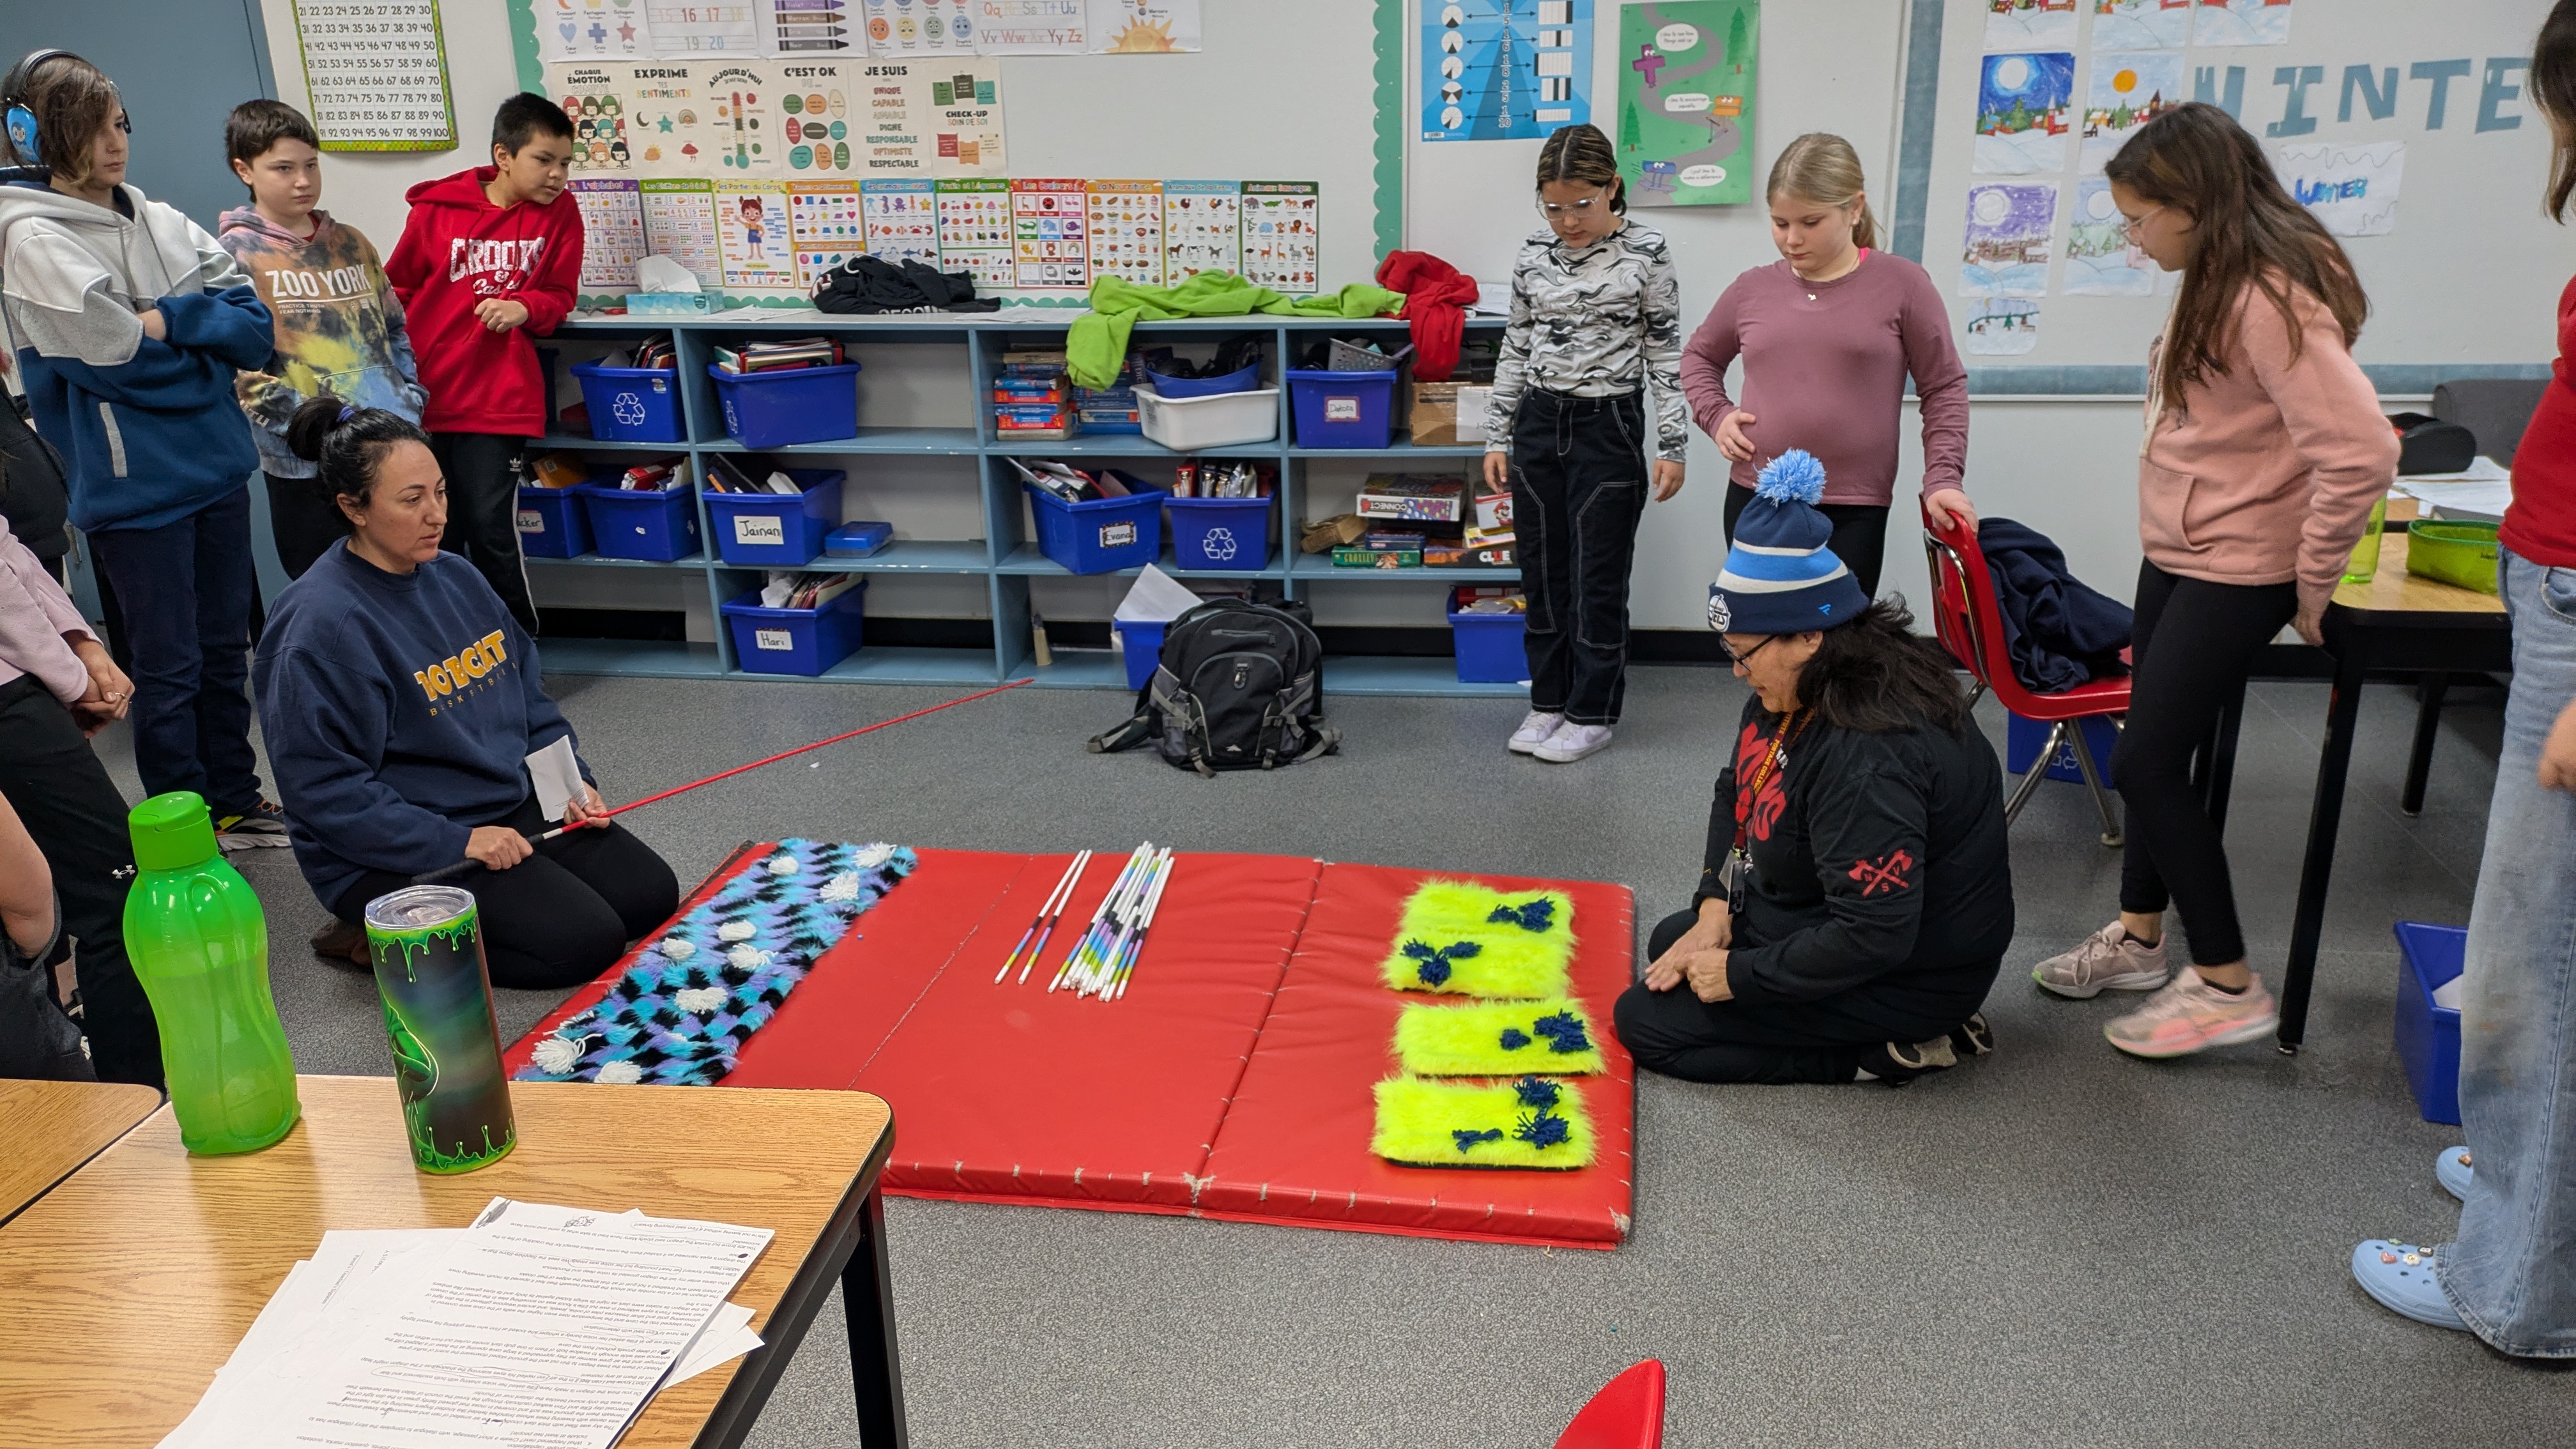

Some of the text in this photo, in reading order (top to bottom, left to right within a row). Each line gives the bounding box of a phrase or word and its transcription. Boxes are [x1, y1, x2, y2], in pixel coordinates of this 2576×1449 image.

[299, 6, 430, 15] 21 22 23 24 25 26 27 28 29 30
[984, 1, 1076, 18] Qq Ss Tt Uu
[1504, 3, 1509, 13] 1
[682, 8, 696, 22] 16
[707, 8, 719, 22] 17
[1504, 15, 1509, 26] 5
[303, 24, 433, 33] 31 32 33 34 35 36 37 38 39 40
[981, 29, 1082, 45] Vv Ww Yy Zz
[686, 36, 724, 50] 19 20
[1503, 41, 1510, 52] 6
[1503, 54, 1508, 64] 1
[634, 69, 688, 78] EXPRIME
[785, 67, 836, 77] C'EST OK
[865, 66, 907, 75] JE SUIS
[1503, 66, 1510, 77] 8
[567, 74, 610, 84] ÉMOTION
[709, 68, 762, 88] AUJOURD'HUI
[572, 84, 610, 95] COMPTE
[1503, 80, 1508, 89] 2
[636, 89, 691, 98] SENTIMENTS
[1502, 92, 1508, 102] 5
[2193, 57, 2536, 139] WINTE
[872, 99, 905, 107] CAPABLE
[1499, 118, 1511, 128] 10
[866, 135, 917, 144] RESPONSABLE
[449, 236, 545, 282] CROOKS
[265, 264, 372, 297] ZOO YORK
[494, 270, 509, 282] &
[1330, 404, 1354, 413] Dakota
[1361, 499, 1407, 512] CONNECT 4
[1479, 551, 1510, 562] CLUE
[761, 632, 784, 646] Hari
[1865, 866, 1899, 881] N V
[1882, 882, 1889, 892] S
